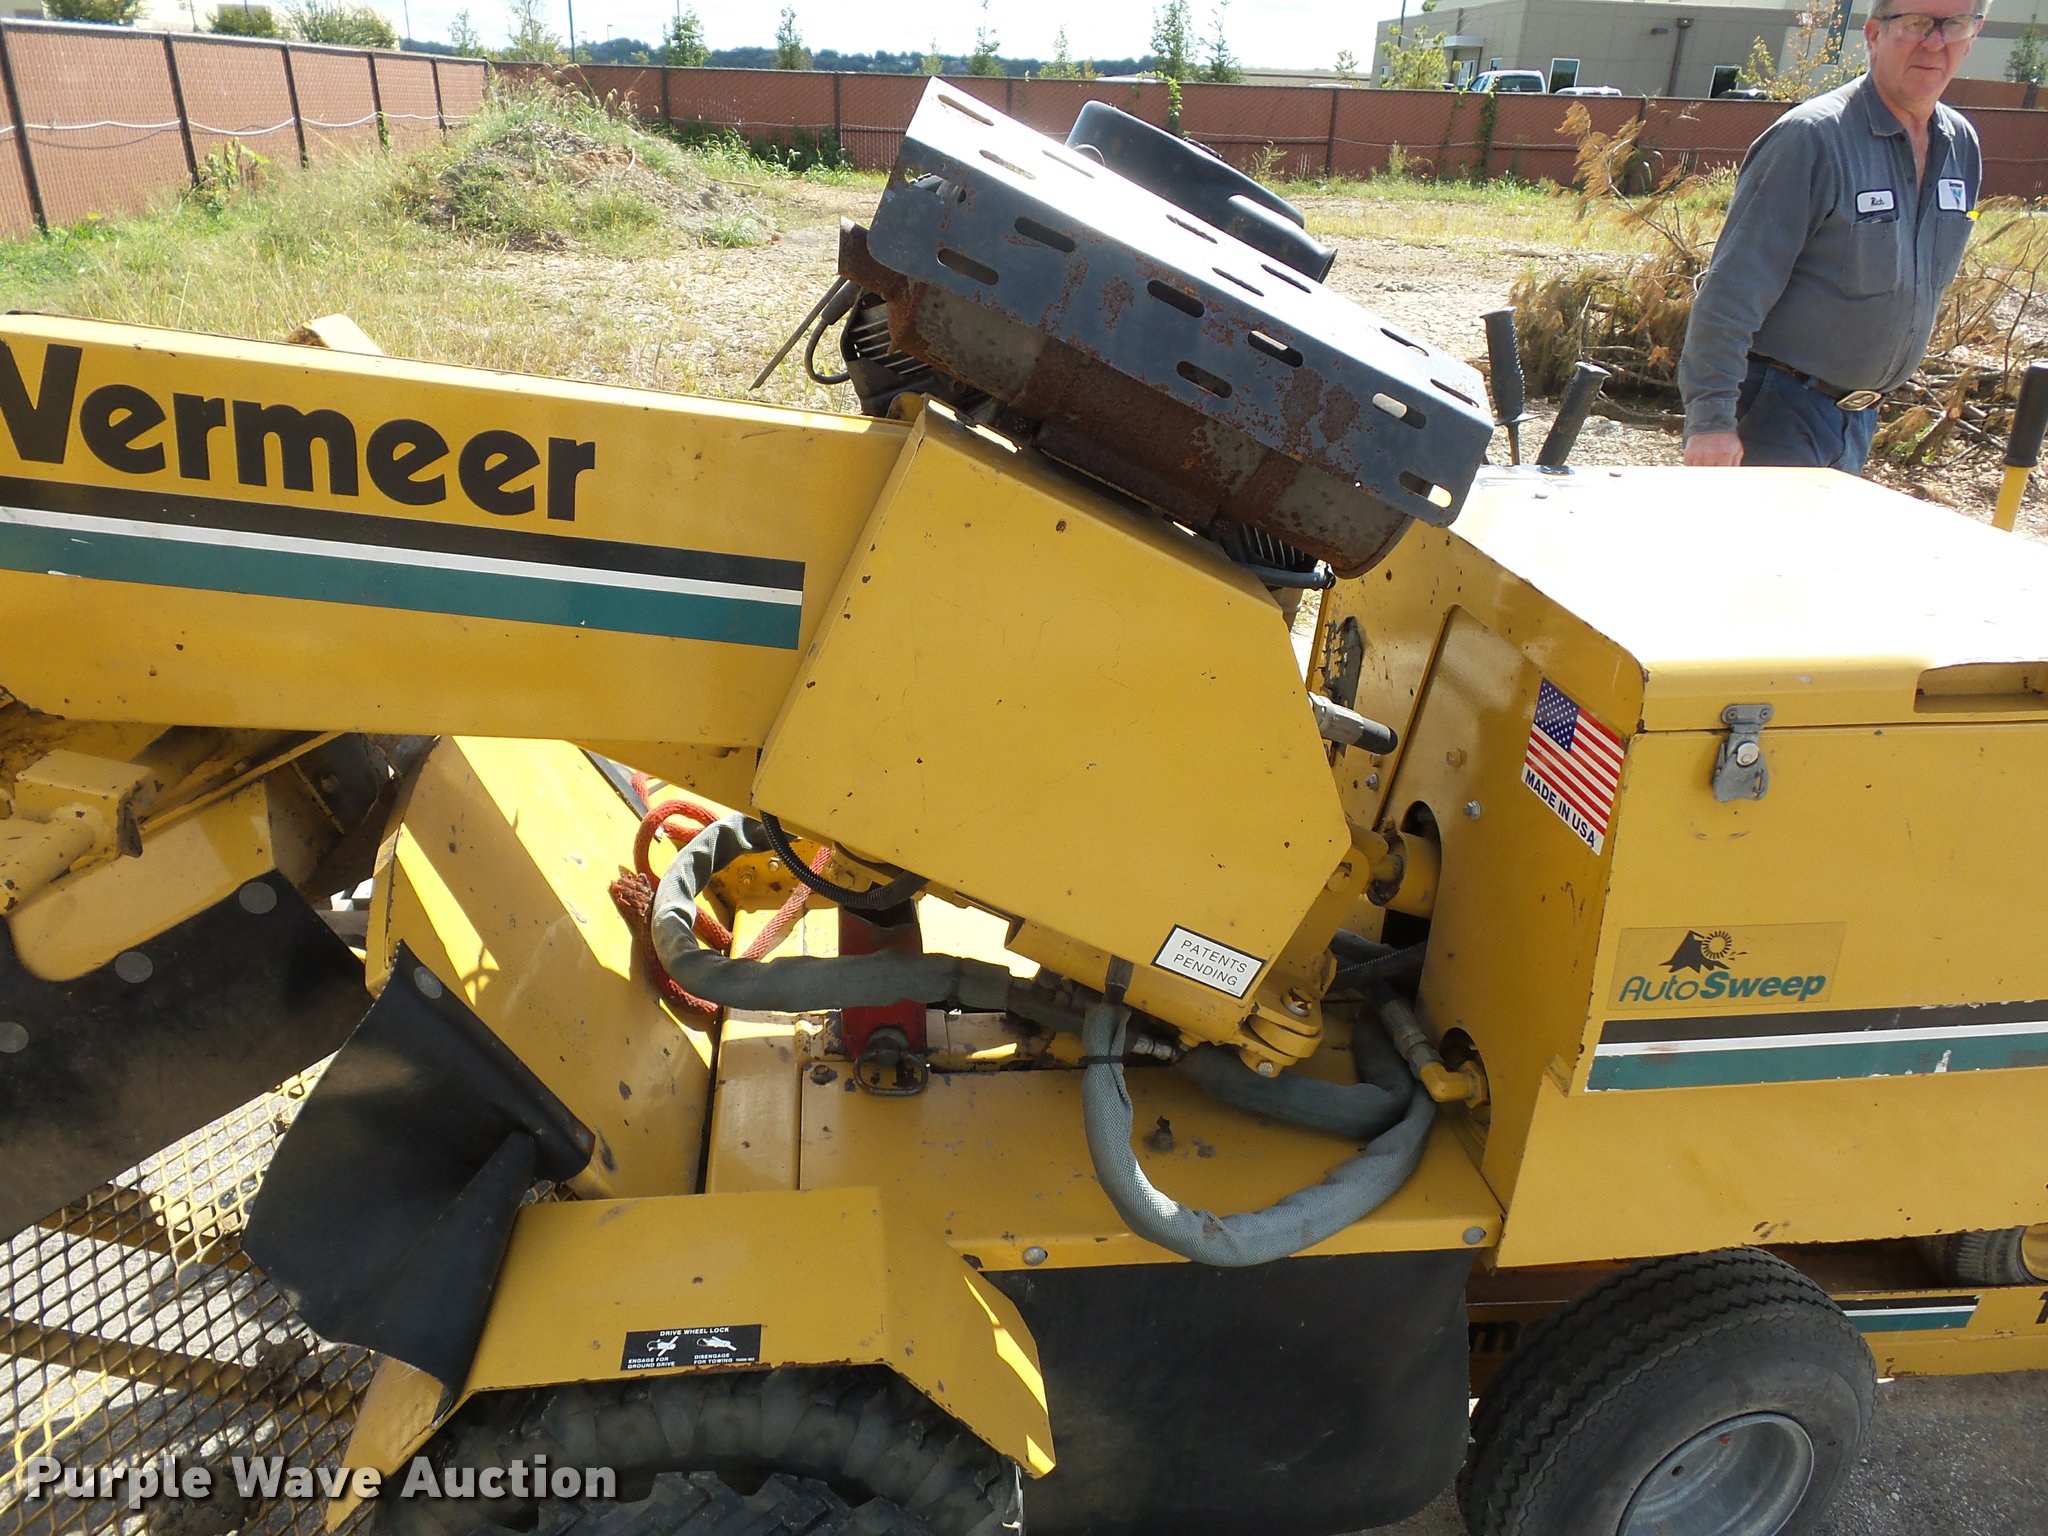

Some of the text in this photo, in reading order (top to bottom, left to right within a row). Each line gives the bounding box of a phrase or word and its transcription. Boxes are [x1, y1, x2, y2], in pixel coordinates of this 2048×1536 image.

[0, 340, 596, 522] Vermeer
[1525, 770, 1595, 847] MADE IN USA
[1173, 953, 1238, 986] PENDING
[1180, 939, 1248, 973] PATENTS
